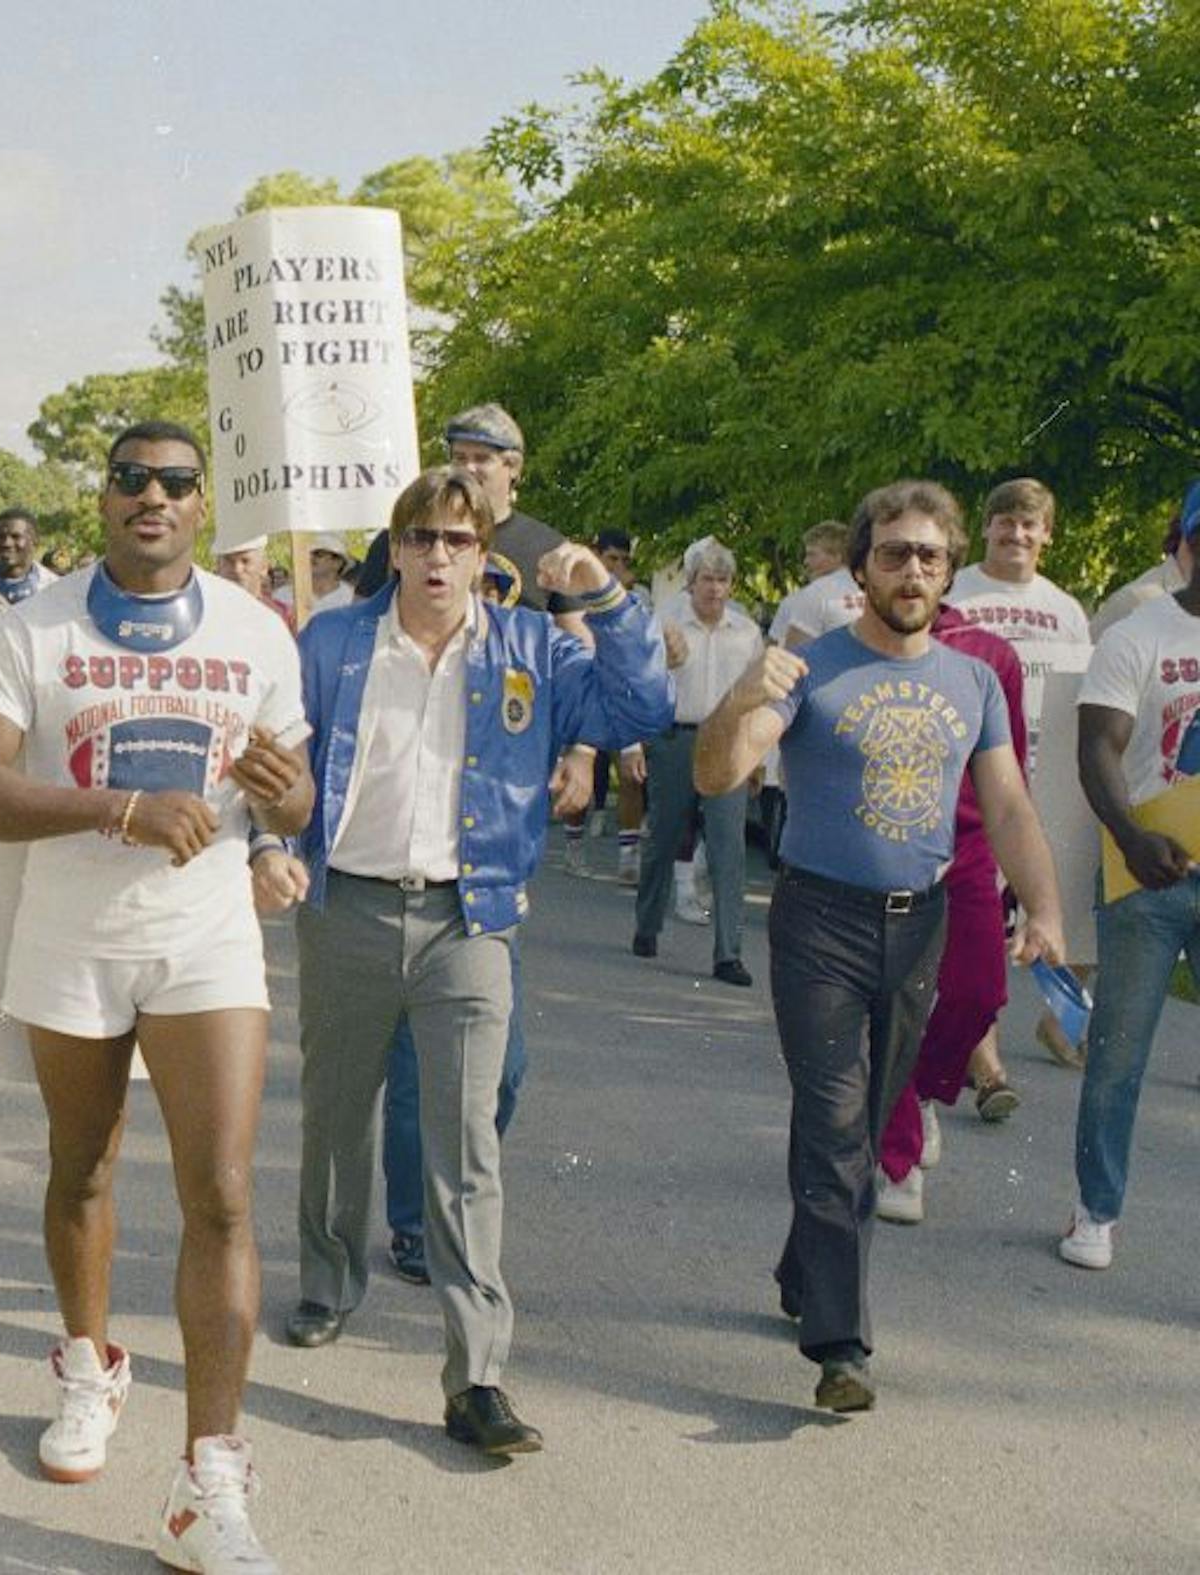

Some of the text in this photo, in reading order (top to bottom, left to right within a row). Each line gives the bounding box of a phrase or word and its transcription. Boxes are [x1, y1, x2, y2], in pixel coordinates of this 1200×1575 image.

[205, 234, 384, 293] NFL PLAYERS
[211, 299, 388, 350] ARE RIGHT
[236, 340, 394, 379] TO FIGHT
[233, 463, 402, 503] DOLPHINS
[63, 655, 251, 696] SUPPORT
[65, 699, 125, 746] NATIONAL
[130, 696, 200, 718] FOOTBALL
[834, 680, 967, 738] TEAMSTERS
[855, 806, 908, 842] LOCAL
